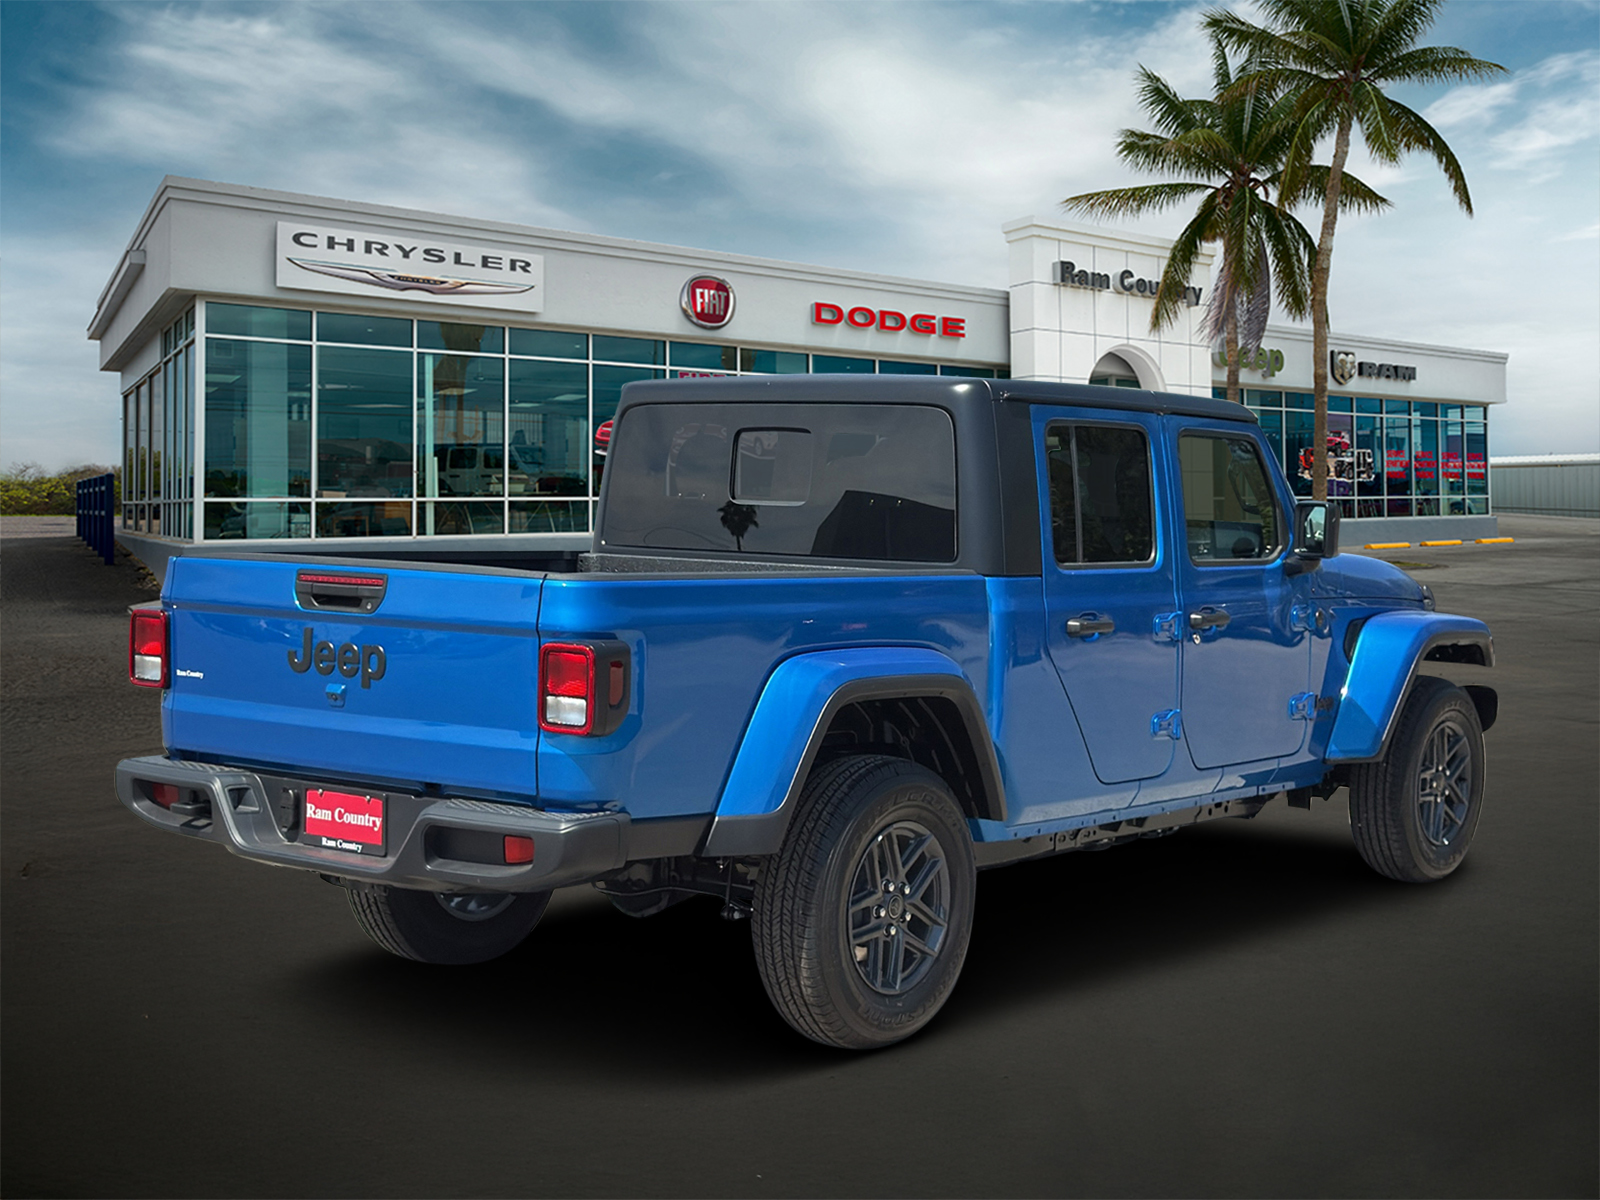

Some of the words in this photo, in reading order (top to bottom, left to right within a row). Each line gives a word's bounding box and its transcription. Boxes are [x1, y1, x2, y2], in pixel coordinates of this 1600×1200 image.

[292, 232, 532, 273] CHRYSLER
[1054, 260, 1110, 290] Ram
[695, 287, 728, 316] FIAT
[812, 301, 966, 339] DODGE
[1358, 361, 1416, 381] RAM
[287, 627, 386, 689] Jeep
[176, 669, 187, 677] Ram
[187, 670, 204, 680] Country
[306, 803, 332, 821] Ram
[334, 807, 382, 832] Country
[322, 837, 337, 848] Ram
[337, 839, 363, 853] Country
